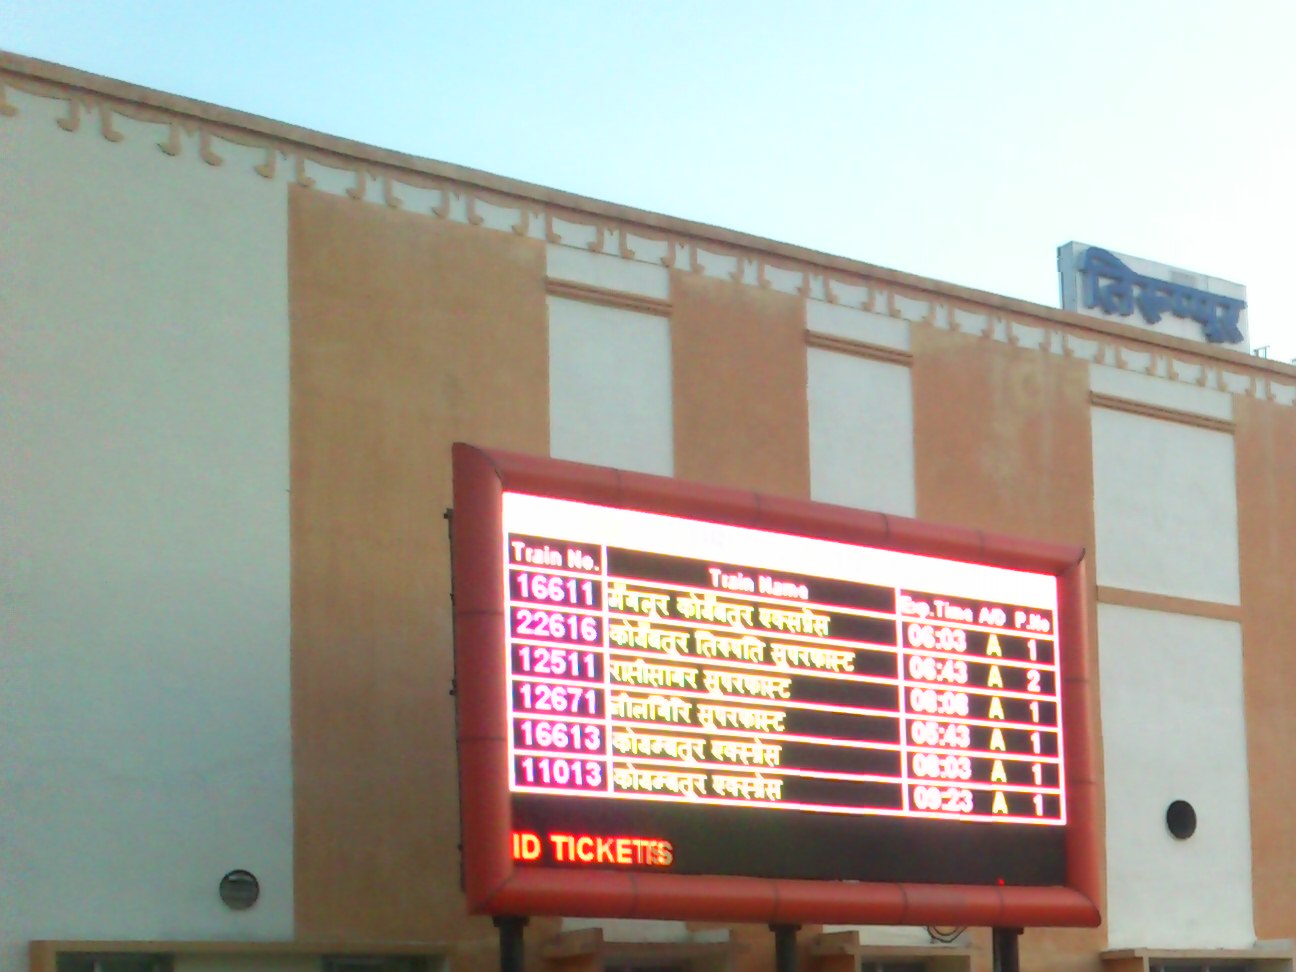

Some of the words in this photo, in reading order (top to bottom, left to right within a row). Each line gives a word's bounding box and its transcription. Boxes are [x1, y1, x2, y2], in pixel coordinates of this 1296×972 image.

[512, 541, 562, 567] Train
[568, 549, 600, 571] No.
[517, 573, 593, 605] 16611
[709, 568, 754, 592] Train
[759, 576, 808, 599] Name
[516, 609, 598, 642] 22616
[979, 608, 1006, 626] A/D
[519, 646, 594, 678] 12511
[987, 634, 1001, 657] A
[1027, 639, 1036, 660] 1
[988, 665, 1003, 688] A
[1027, 669, 1040, 692] 2
[520, 682, 596, 714] 12671
[989, 696, 1004, 719] A
[1030, 701, 1039, 722] 1
[521, 720, 601, 750] 16613
[911, 721, 970, 748] 05:43
[990, 728, 1005, 751] A
[1031, 732, 1040, 754] 1
[522, 757, 602, 787] 11013
[991, 759, 1006, 782] A
[1032, 763, 1041, 785] 1
[993, 791, 1008, 814] A
[1033, 794, 1043, 816] 1
[512, 833, 541, 860] ID
